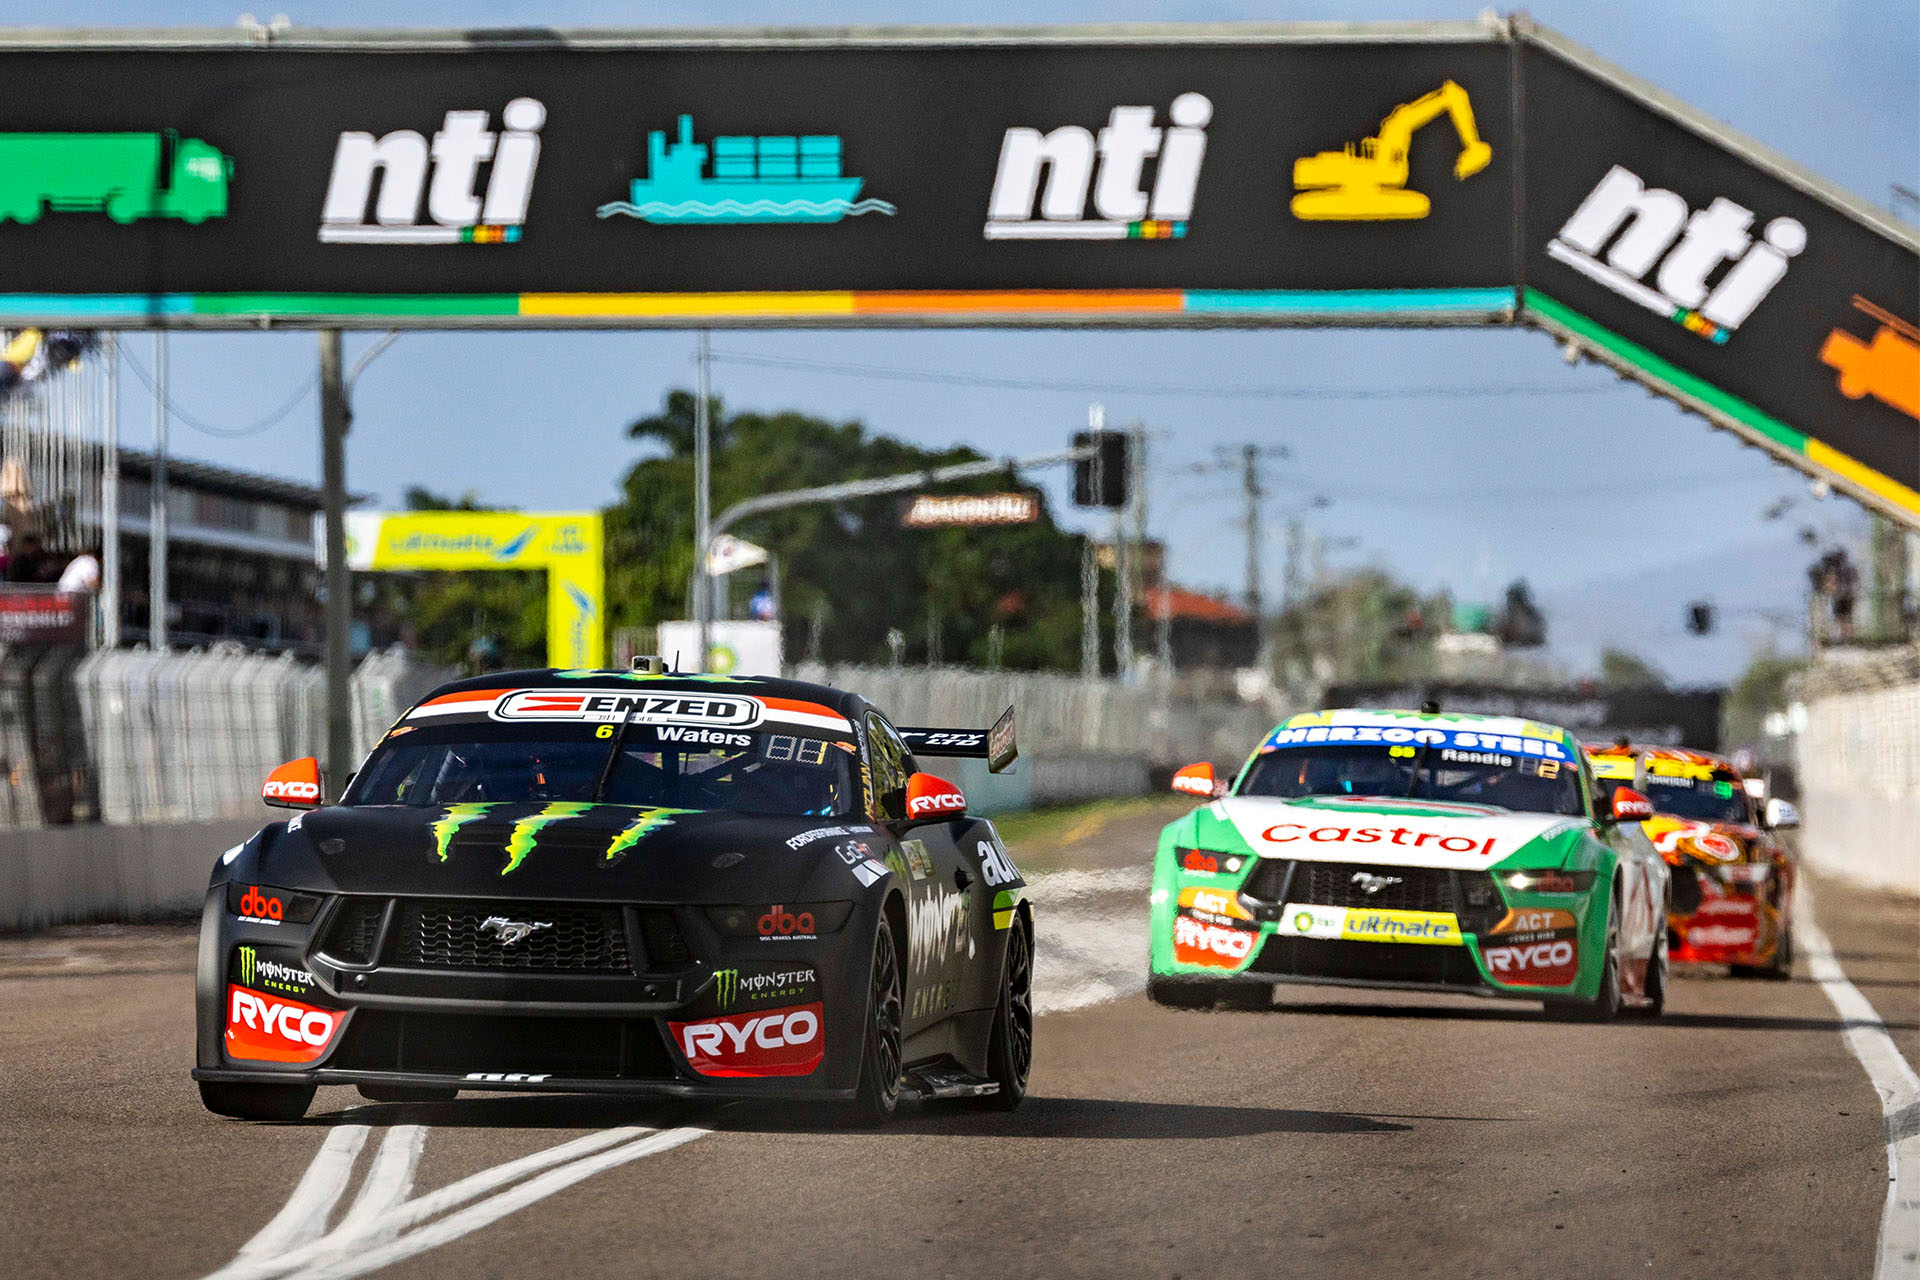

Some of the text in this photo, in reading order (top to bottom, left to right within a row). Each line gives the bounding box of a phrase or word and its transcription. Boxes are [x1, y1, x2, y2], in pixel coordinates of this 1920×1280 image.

[321, 97, 547, 226] nti
[987, 91, 1214, 220] nti
[1559, 164, 1807, 329] nti
[585, 696, 738, 718] ENZED
[595, 724, 614, 739] 6
[656, 726, 751, 746] Waters
[928, 733, 985, 741] PTY
[1454, 732, 1566, 759] STEEL
[1442, 748, 1513, 767] Randle
[262, 781, 320, 798] RYCO
[910, 794, 966, 813] RYCO
[1260, 823, 1497, 855] Castrol
[240, 885, 283, 920] dba
[757, 904, 816, 935] dba
[1349, 915, 1450, 938] ultimate
[1515, 912, 1555, 931] ACT
[1485, 941, 1573, 972] RYCO
[256, 960, 315, 987] MONSTER
[739, 969, 816, 991] MONSTER
[264, 979, 307, 994] ENERGY
[751, 986, 805, 1000] ENERGY
[232, 990, 334, 1046] RYCO
[683, 1010, 818, 1059] RYCO
